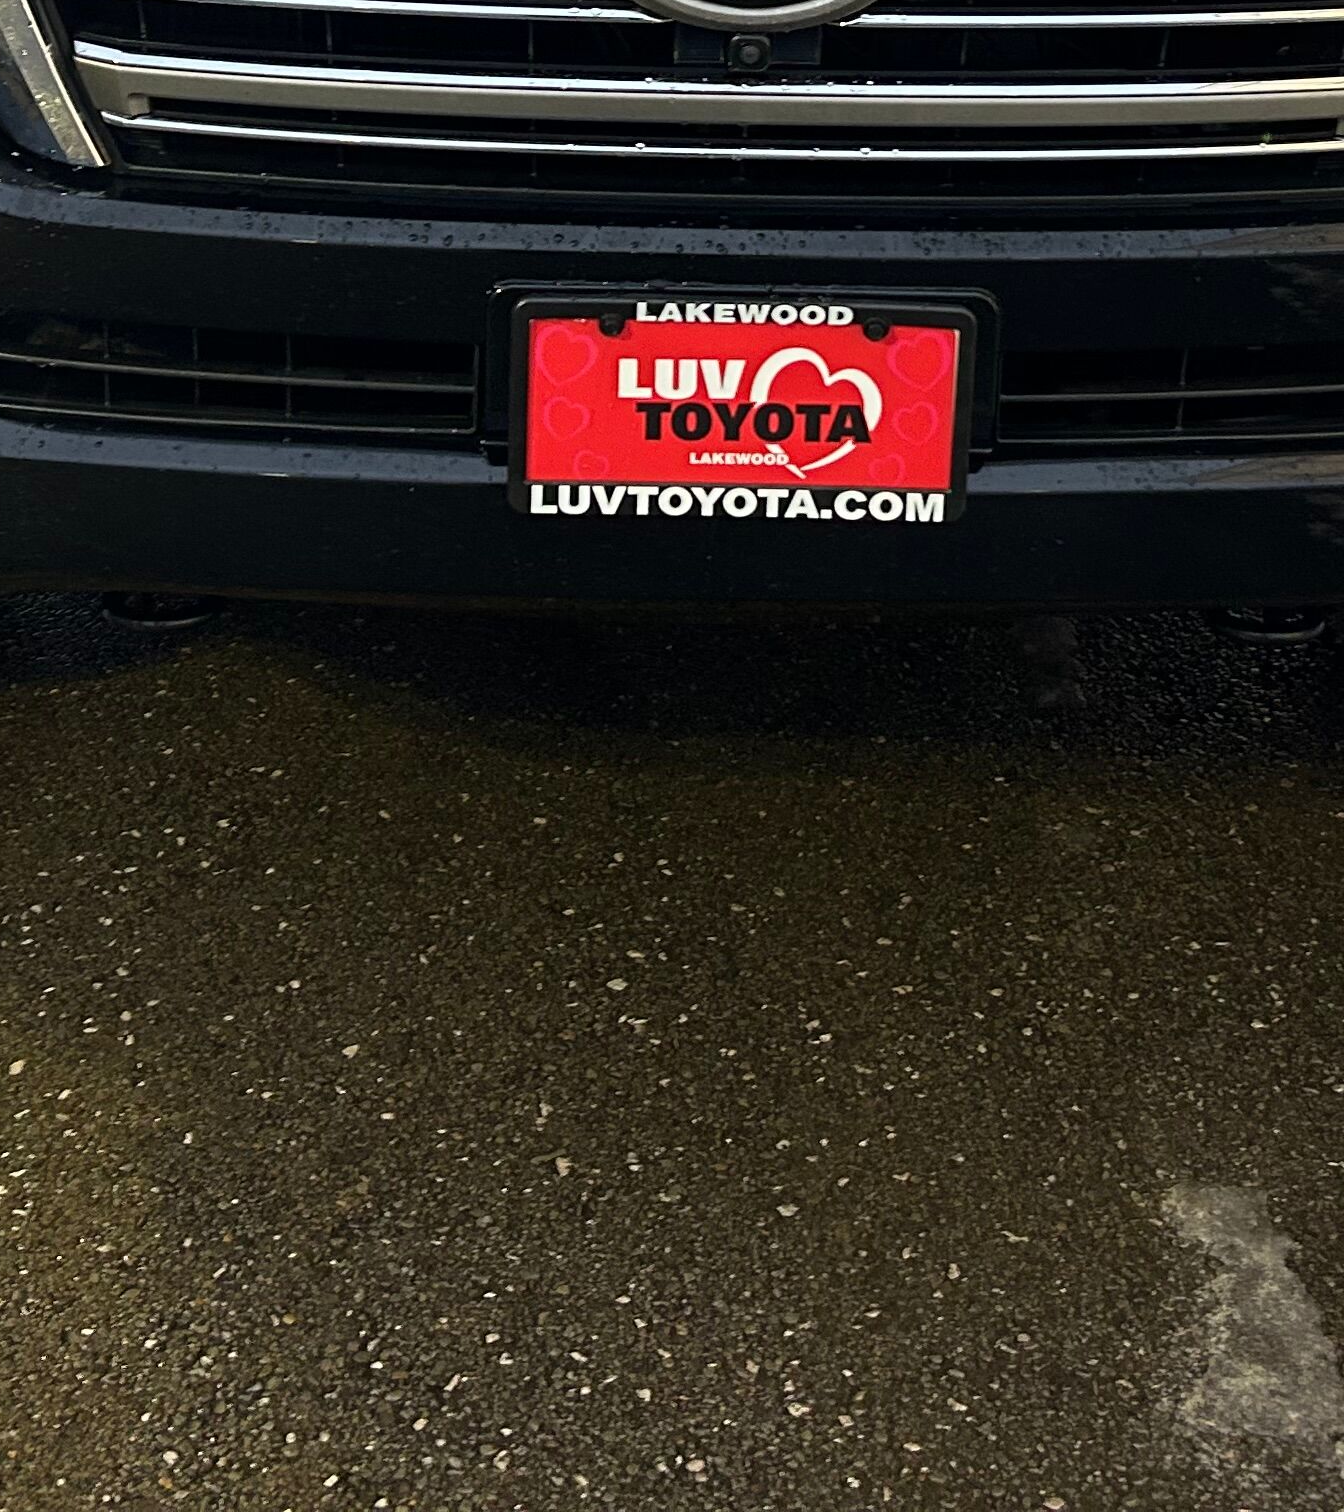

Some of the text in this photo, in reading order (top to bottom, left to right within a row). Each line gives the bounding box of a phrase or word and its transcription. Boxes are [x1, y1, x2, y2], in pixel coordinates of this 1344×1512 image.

[636, 300, 855, 327] LAKEWOOD
[617, 357, 747, 400] LUV
[635, 402, 872, 444] TOYOTA
[688, 452, 790, 467] LAKEWOOD
[529, 484, 945, 523] LUVTOYOTA.COM
